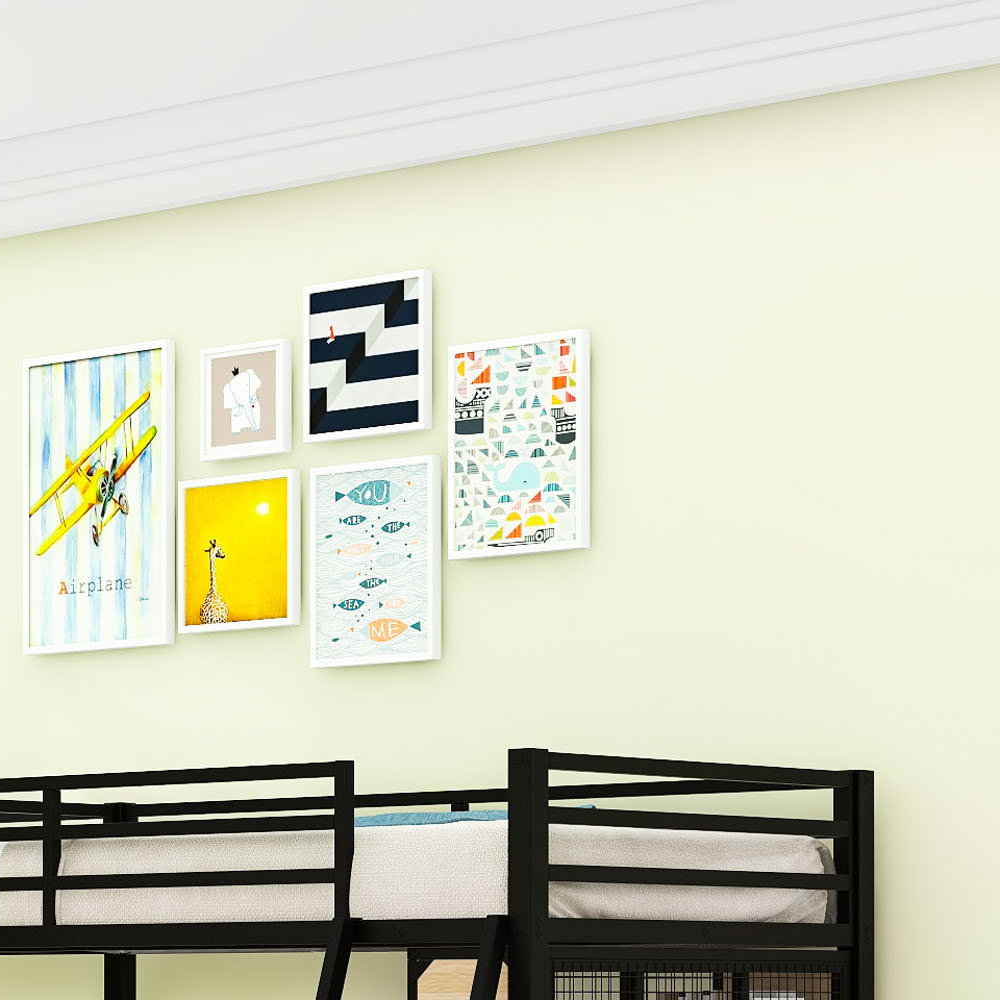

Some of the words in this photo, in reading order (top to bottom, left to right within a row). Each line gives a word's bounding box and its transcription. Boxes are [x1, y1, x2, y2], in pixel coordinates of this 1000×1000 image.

[355, 483, 387, 503] YOU
[347, 516, 362, 525] ARE
[387, 522, 401, 533] THE
[58, 576, 132, 597] Airplane
[366, 578, 381, 588] THE
[344, 600, 359, 610] SEA
[370, 621, 399, 639] ME
